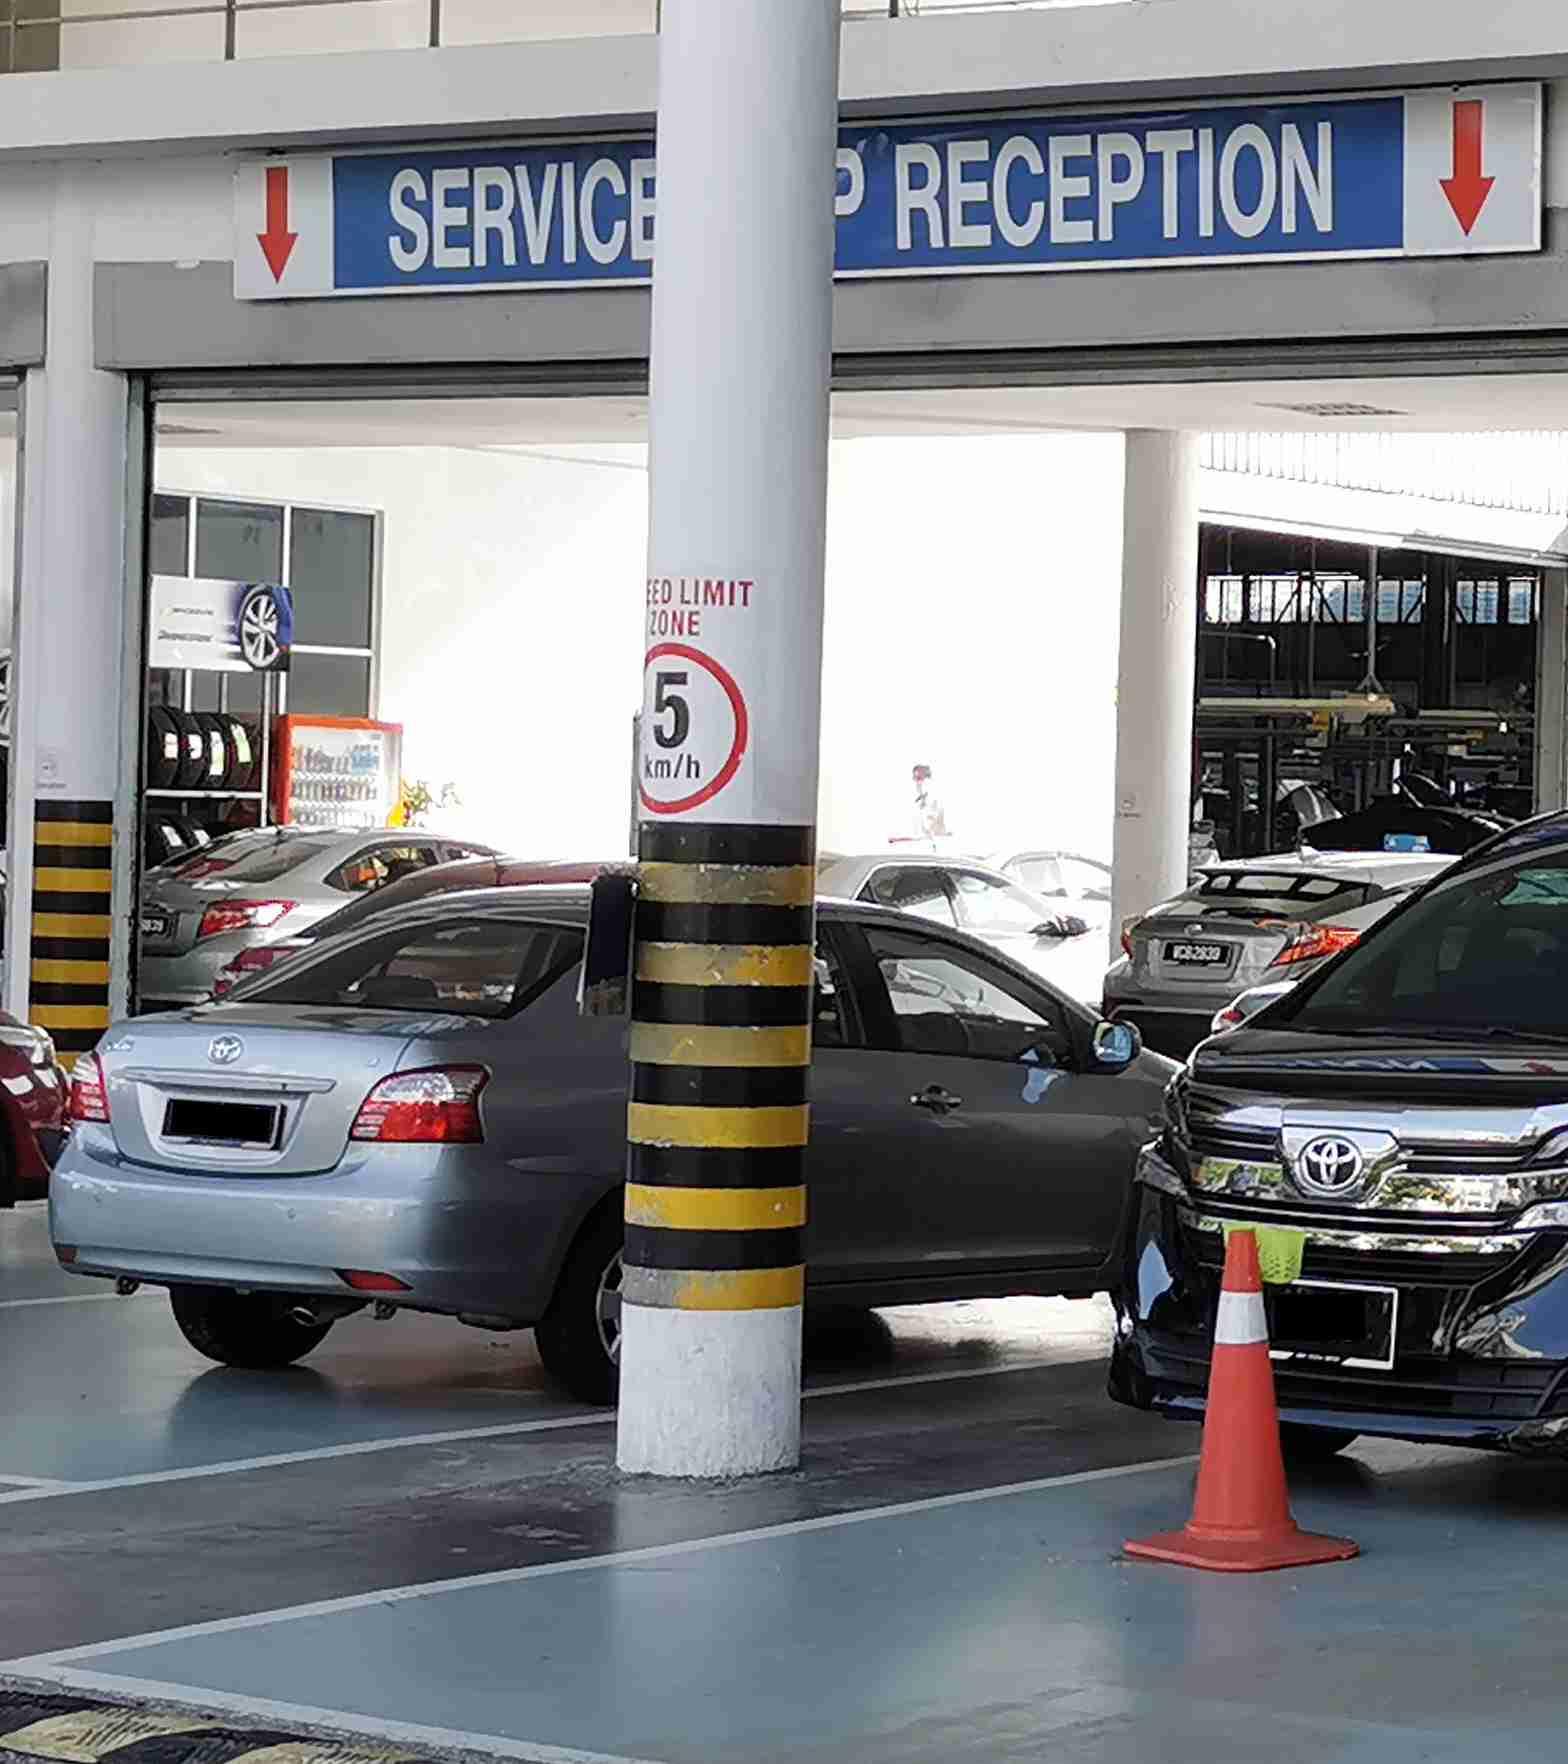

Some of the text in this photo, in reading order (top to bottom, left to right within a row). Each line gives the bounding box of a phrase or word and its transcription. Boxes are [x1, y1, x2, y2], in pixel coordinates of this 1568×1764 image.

[388, 121, 1332, 272] SERVICE P RECEPTION
[680, 579, 753, 607] LIMIT
[650, 609, 700, 636] ZONE
[653, 671, 690, 749] 5
[645, 753, 701, 779] km/h
